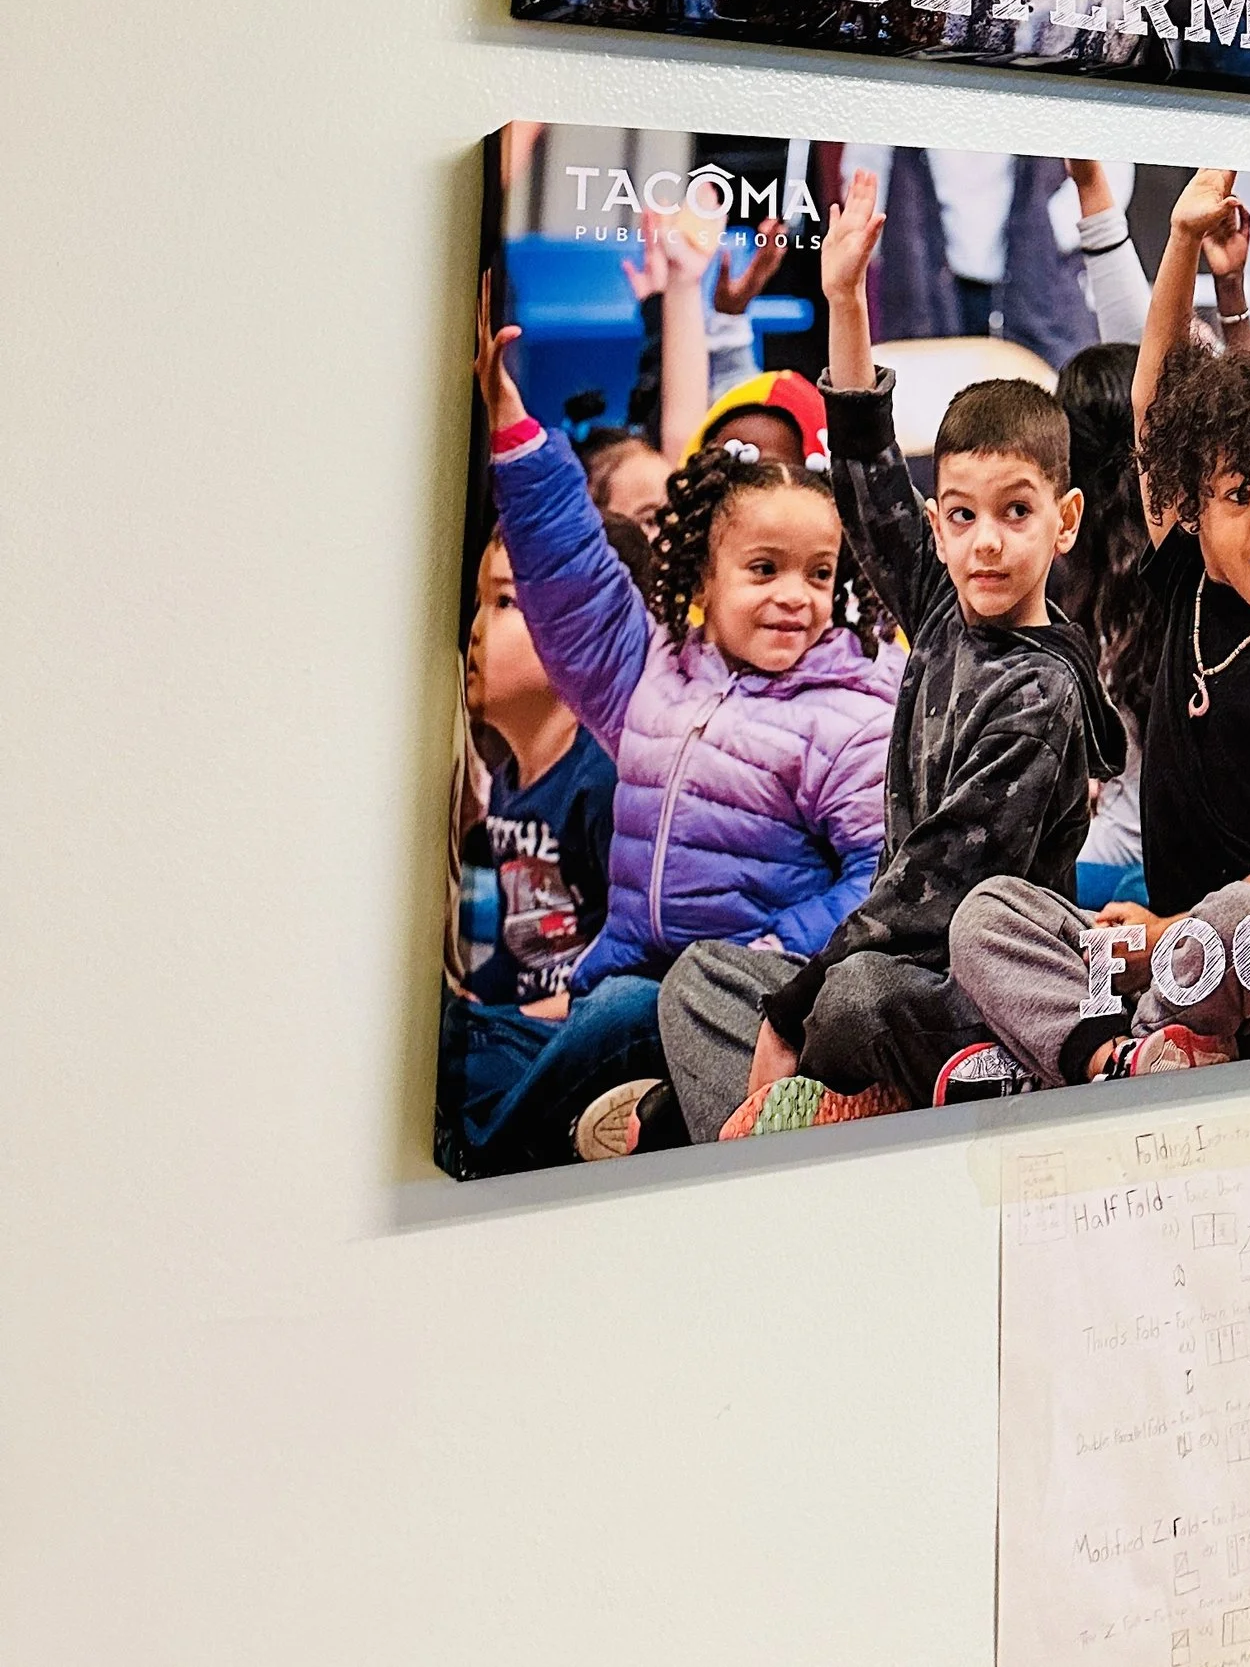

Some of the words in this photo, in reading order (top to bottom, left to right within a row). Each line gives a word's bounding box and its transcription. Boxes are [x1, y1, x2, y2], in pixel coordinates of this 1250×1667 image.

[575, 225, 678, 245] PUBLIC
[700, 231, 822, 251] SCHOOLS
[1135, 1133, 1192, 1168] Folding
[1073, 1193, 1118, 1234] Half
[1125, 1181, 1163, 1220] Fold
